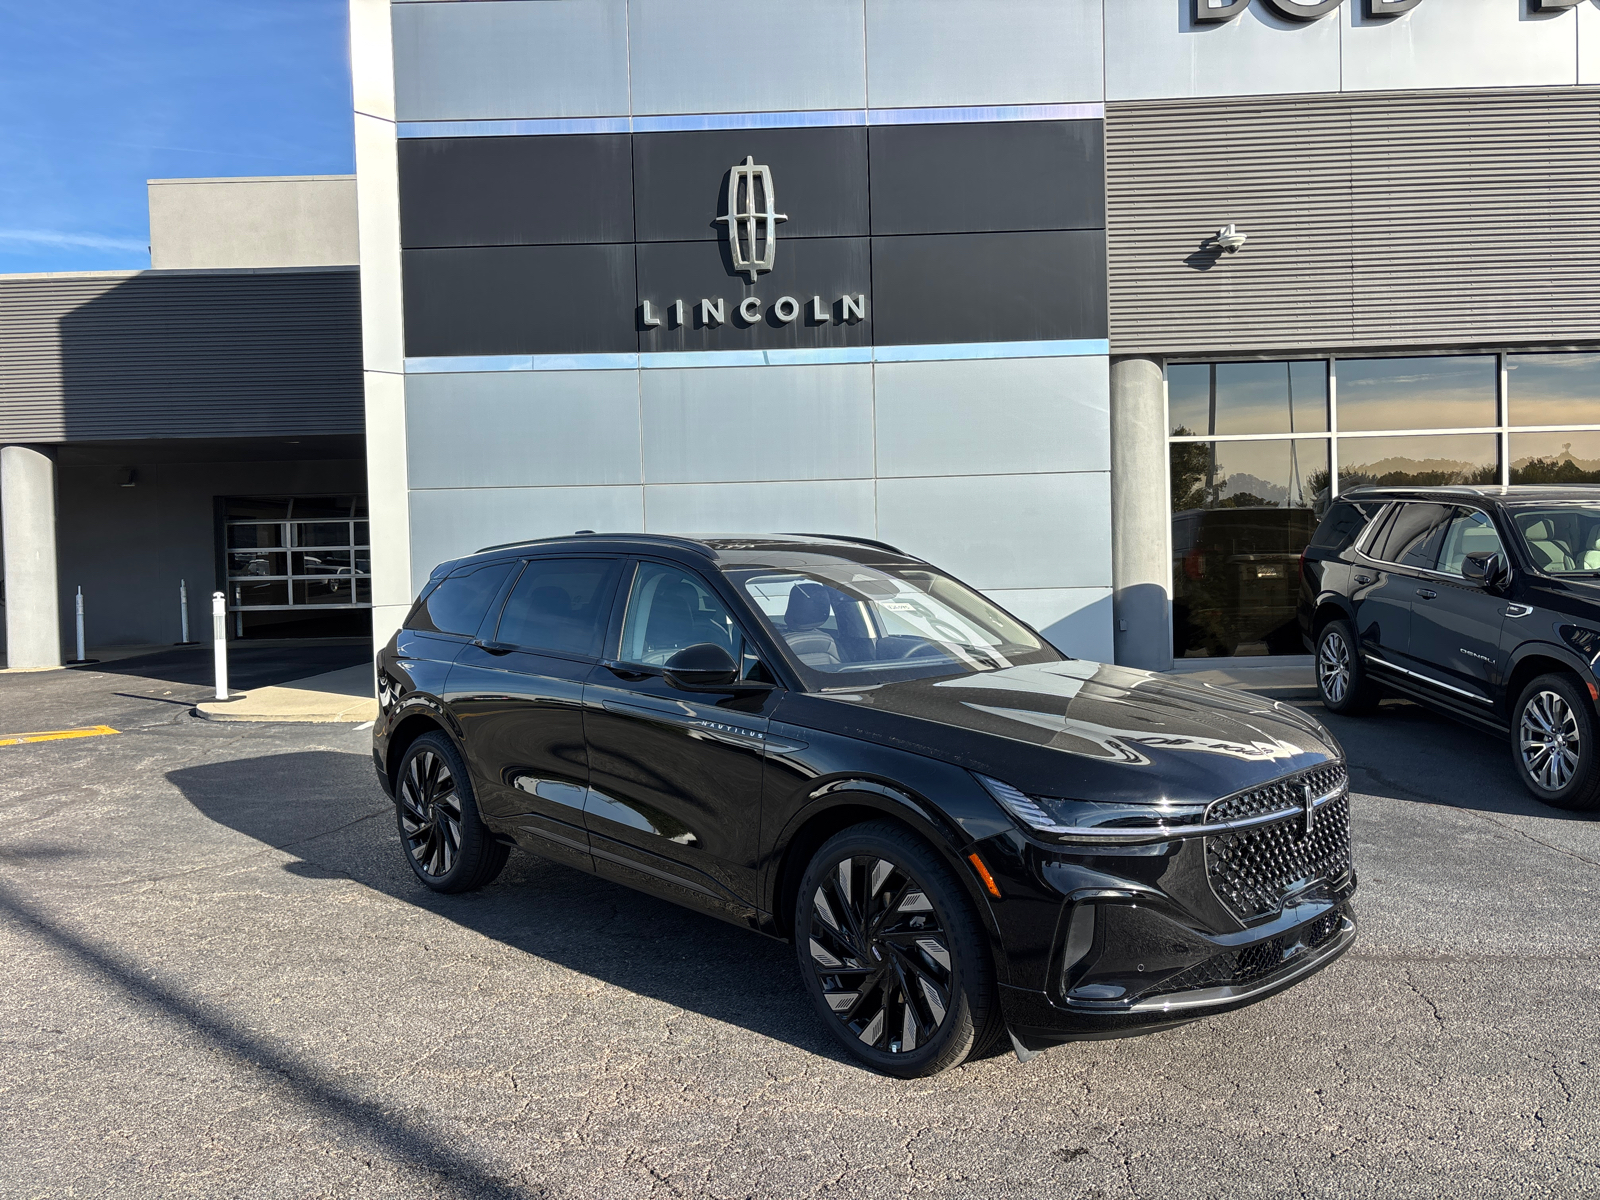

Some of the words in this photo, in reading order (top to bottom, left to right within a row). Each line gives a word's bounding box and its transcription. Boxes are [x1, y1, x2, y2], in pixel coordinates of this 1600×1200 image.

[643, 294, 865, 326] LINCOLN
[1460, 648, 1496, 664] DENALI
[701, 720, 763, 739] NAUTILUS
